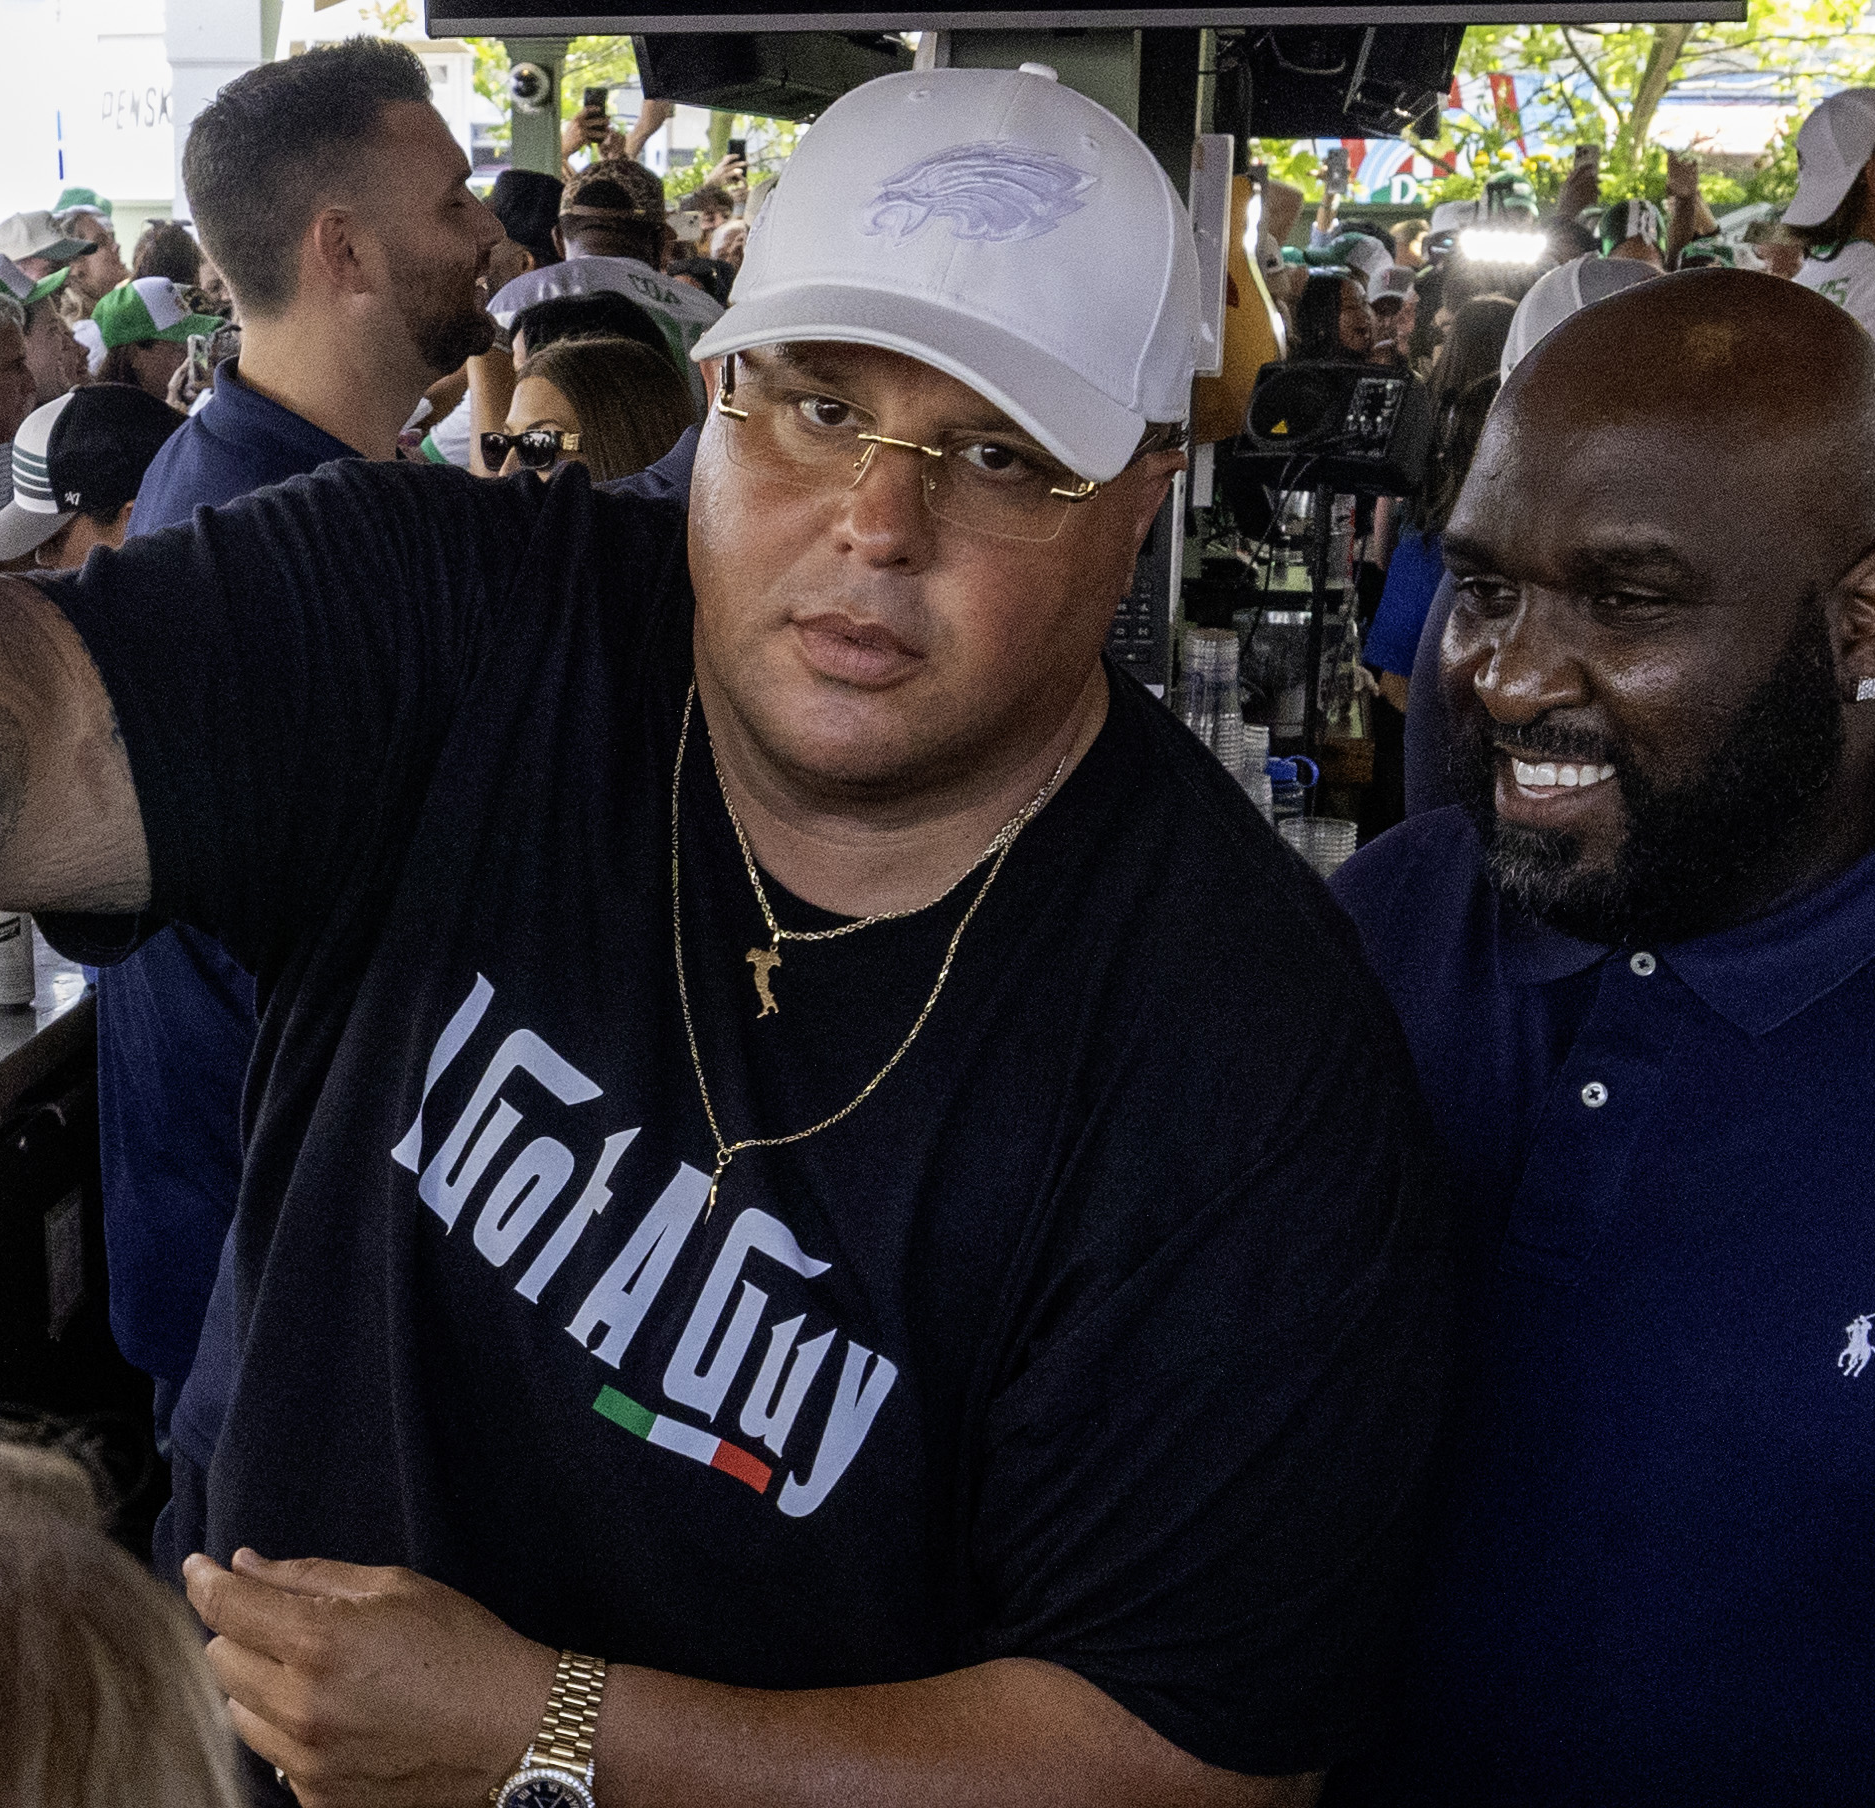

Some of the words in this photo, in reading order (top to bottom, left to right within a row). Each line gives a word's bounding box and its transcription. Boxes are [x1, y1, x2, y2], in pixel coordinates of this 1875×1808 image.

[102, 88, 172, 129] PENSK
[418, 1028, 642, 1305] Got
[564, 1161, 715, 1371] A
[662, 1208, 899, 1518] Guy
